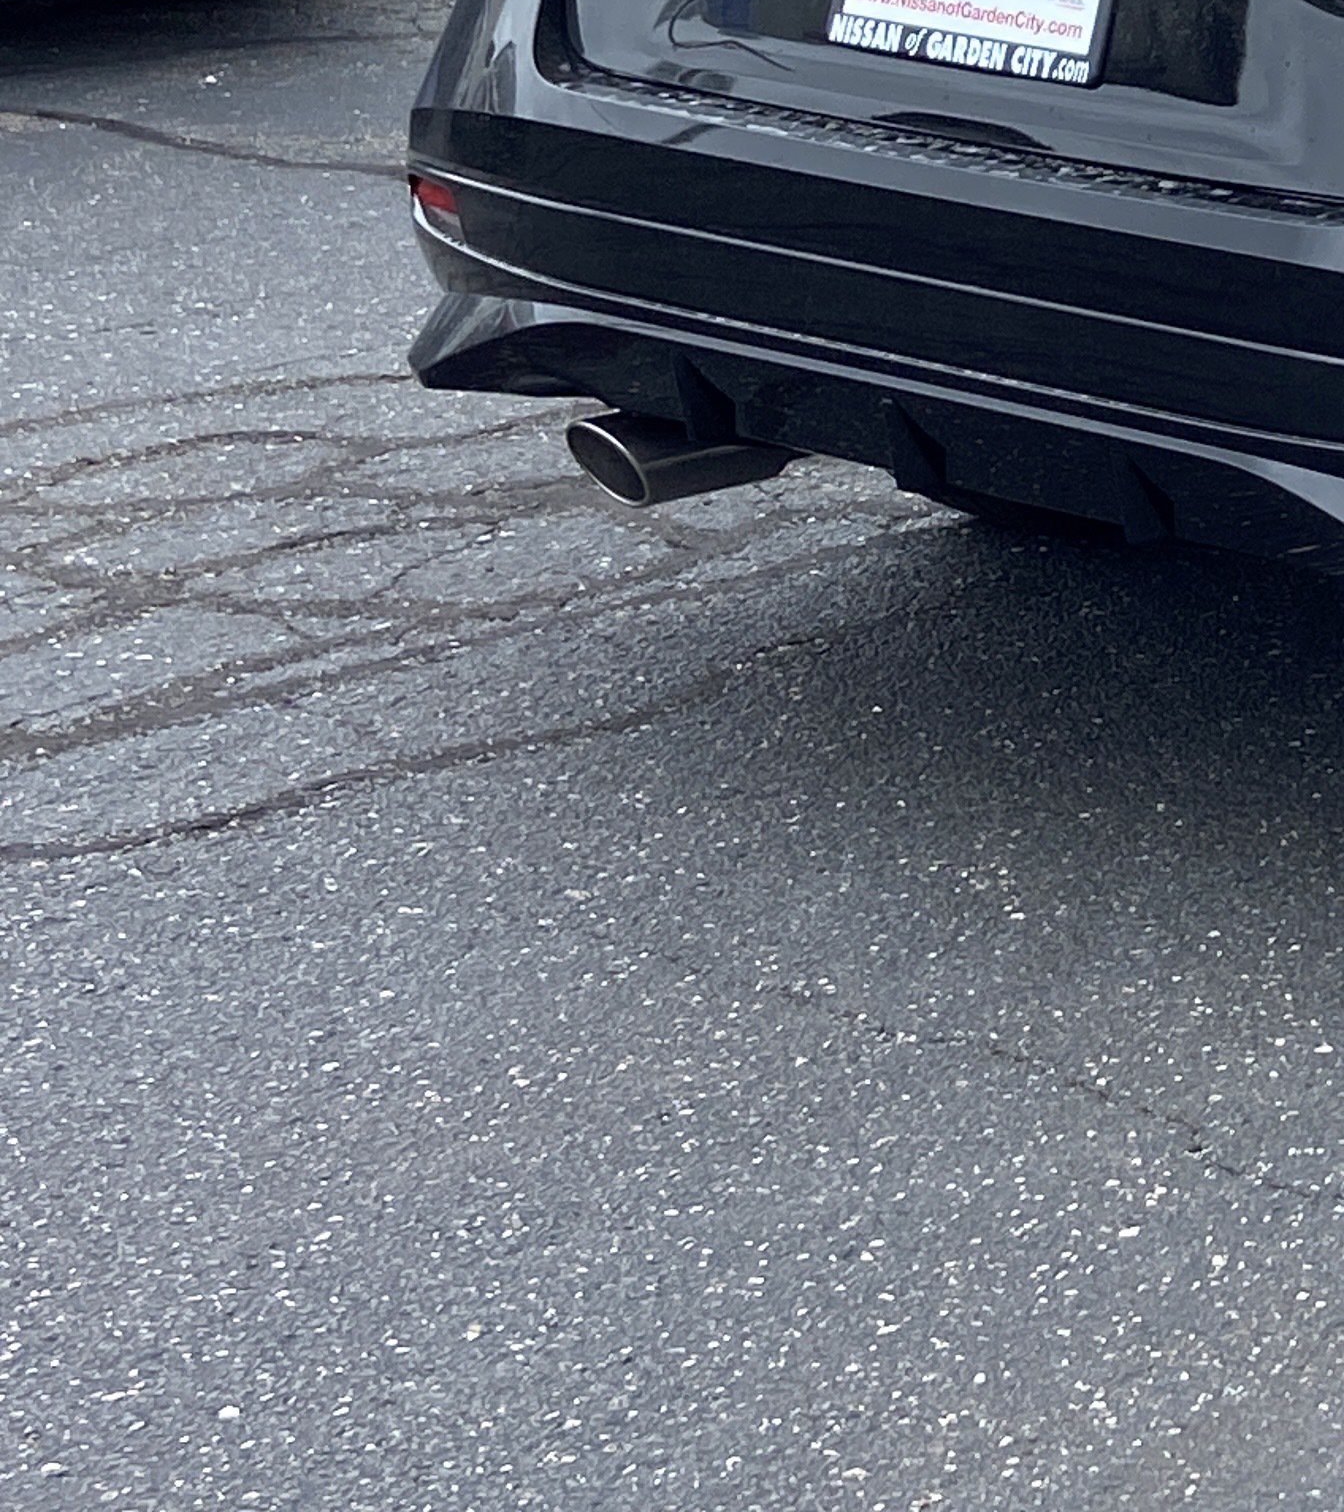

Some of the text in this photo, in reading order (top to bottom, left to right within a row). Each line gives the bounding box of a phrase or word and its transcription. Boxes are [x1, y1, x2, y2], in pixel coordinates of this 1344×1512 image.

[827, 13, 1090, 84] NISSAN of GARDEN CITY.com
